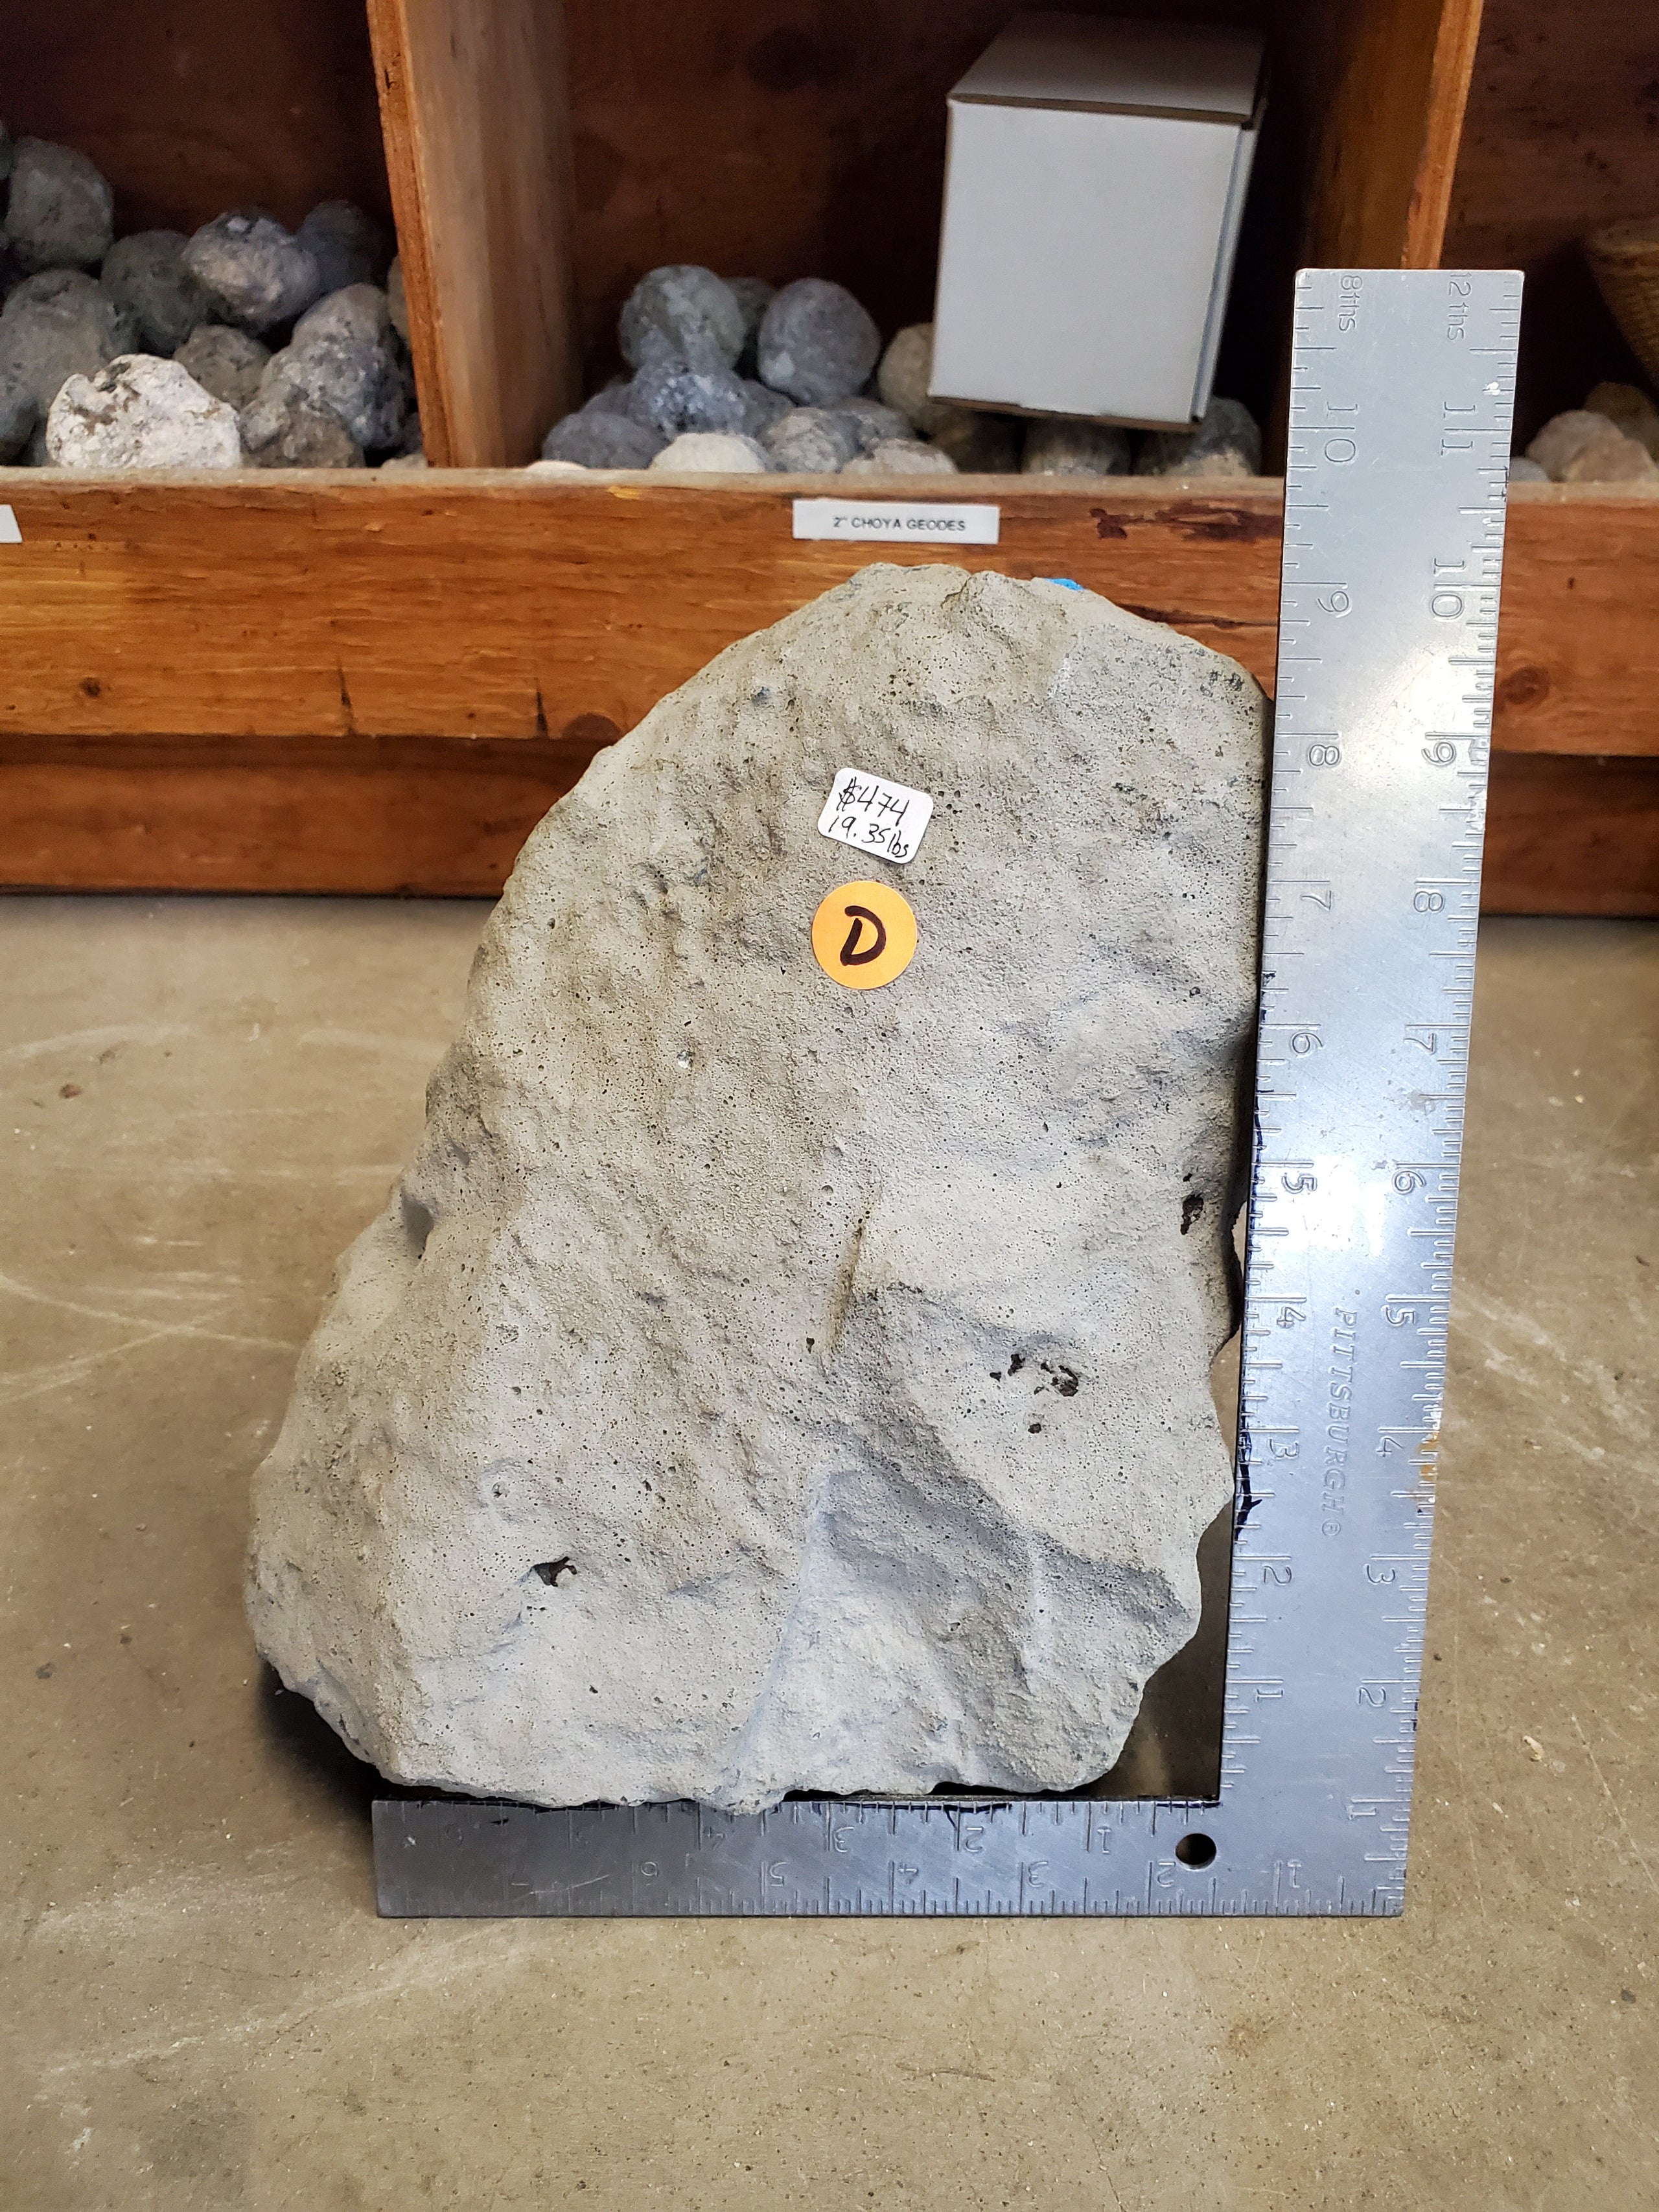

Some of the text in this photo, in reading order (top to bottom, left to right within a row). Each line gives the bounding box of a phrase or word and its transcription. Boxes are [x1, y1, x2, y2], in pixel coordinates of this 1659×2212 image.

[1338, 274, 1363, 333] 8ths
[1324, 401, 1360, 463] 10
[851, 518, 901, 528] CHOYA
[907, 519, 966, 531] GEODES
[1431, 557, 1467, 621] 10
[1308, 743, 1341, 767] 8
[837, 776, 910, 826] $474
[1300, 889, 1332, 912] 7
[1413, 890, 1444, 913] 8
[840, 905, 887, 966] D
[1404, 1032, 1437, 1055] 7
[1281, 1172, 1317, 1194] 5
[1275, 1305, 1306, 1329] 4
[1380, 1303, 1417, 1327] 5
[1375, 1436, 1405, 1458] 4
[1262, 1563, 1293, 1585] 2
[1364, 1563, 1397, 1585] 3
[1358, 1686, 1387, 1707] 2
[833, 1826, 855, 1853] 3
[964, 1826, 984, 1852] 2
[769, 1861, 791, 1887] 5
[1028, 1861, 1049, 1888] 3
[1157, 1859, 1176, 1888] 2
